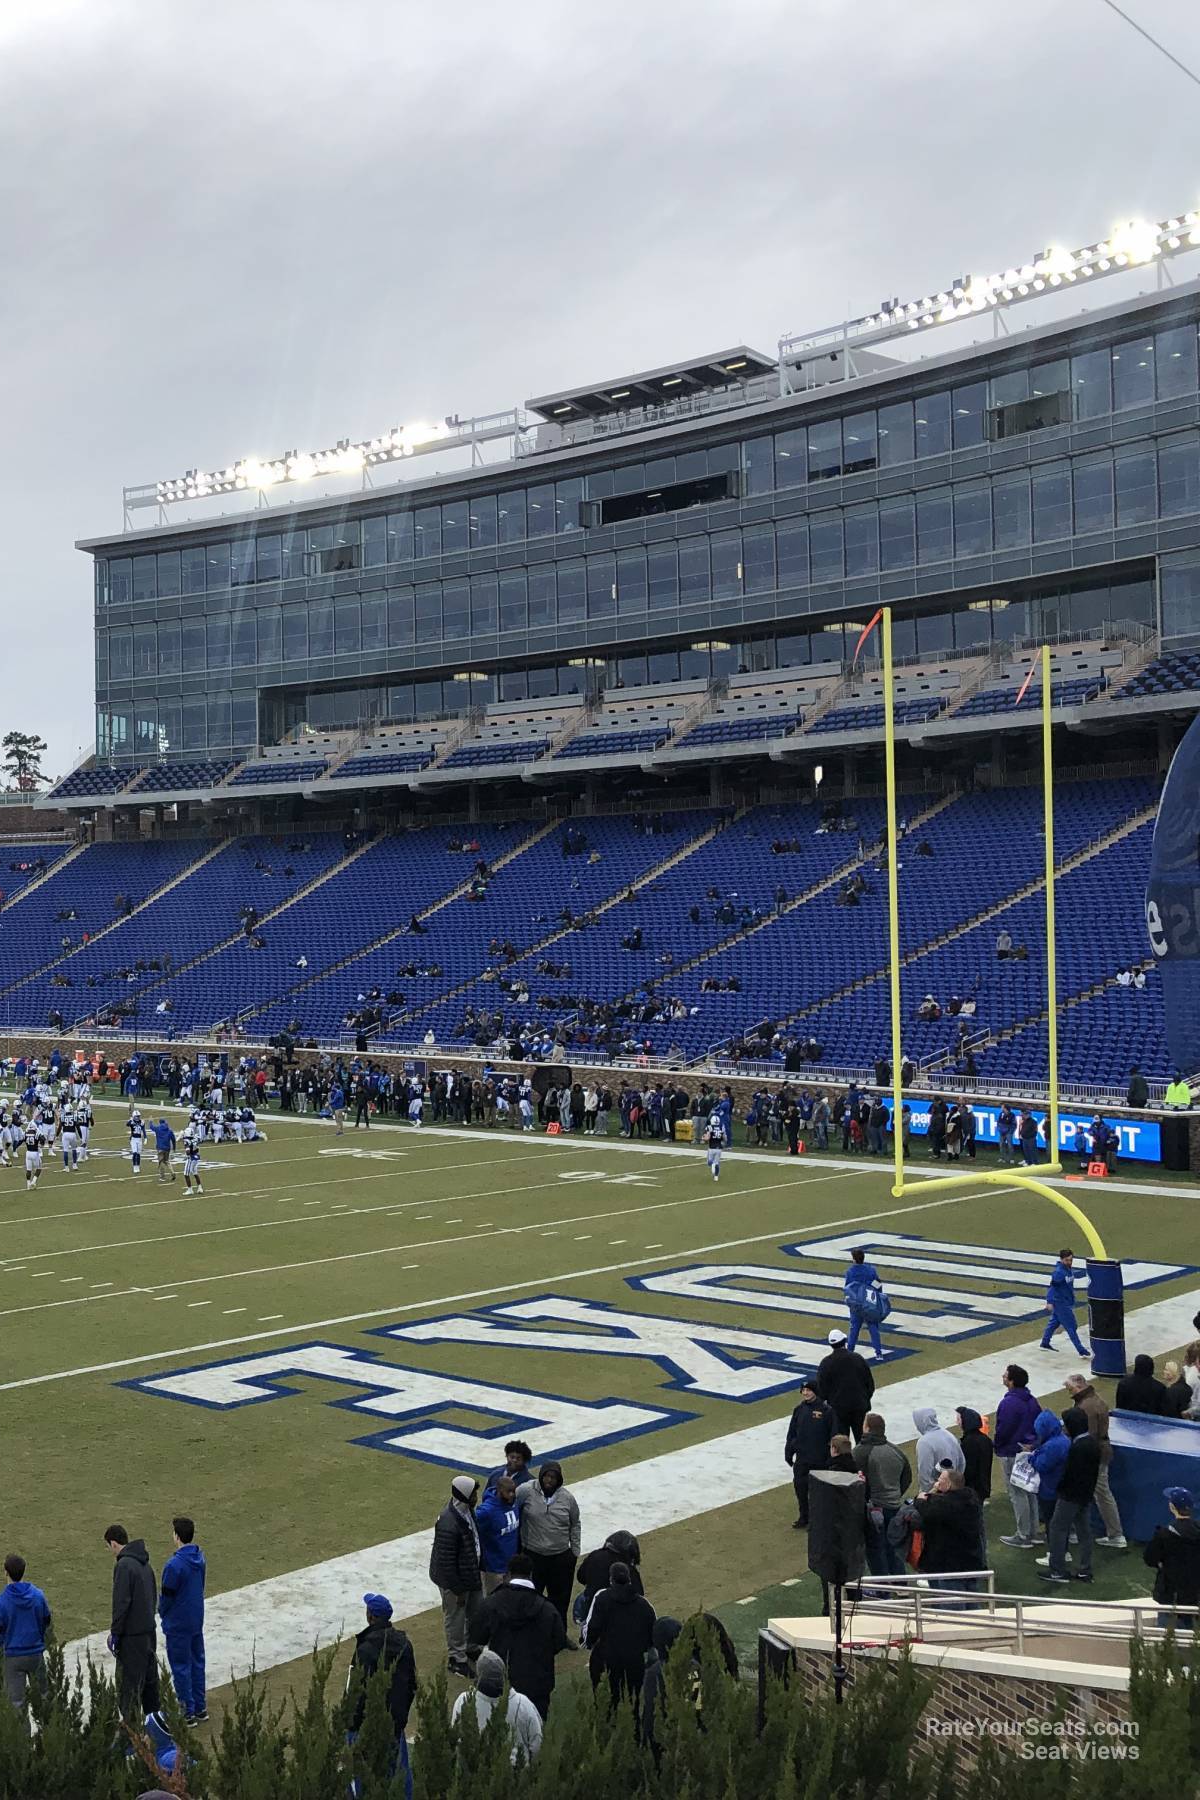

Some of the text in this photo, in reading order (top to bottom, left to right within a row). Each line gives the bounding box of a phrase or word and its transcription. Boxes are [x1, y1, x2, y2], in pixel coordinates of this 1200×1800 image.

[64, 1118, 74, 1127] 95
[548, 1124, 558, 1134] 20
[1090, 1164, 1101, 1175] G
